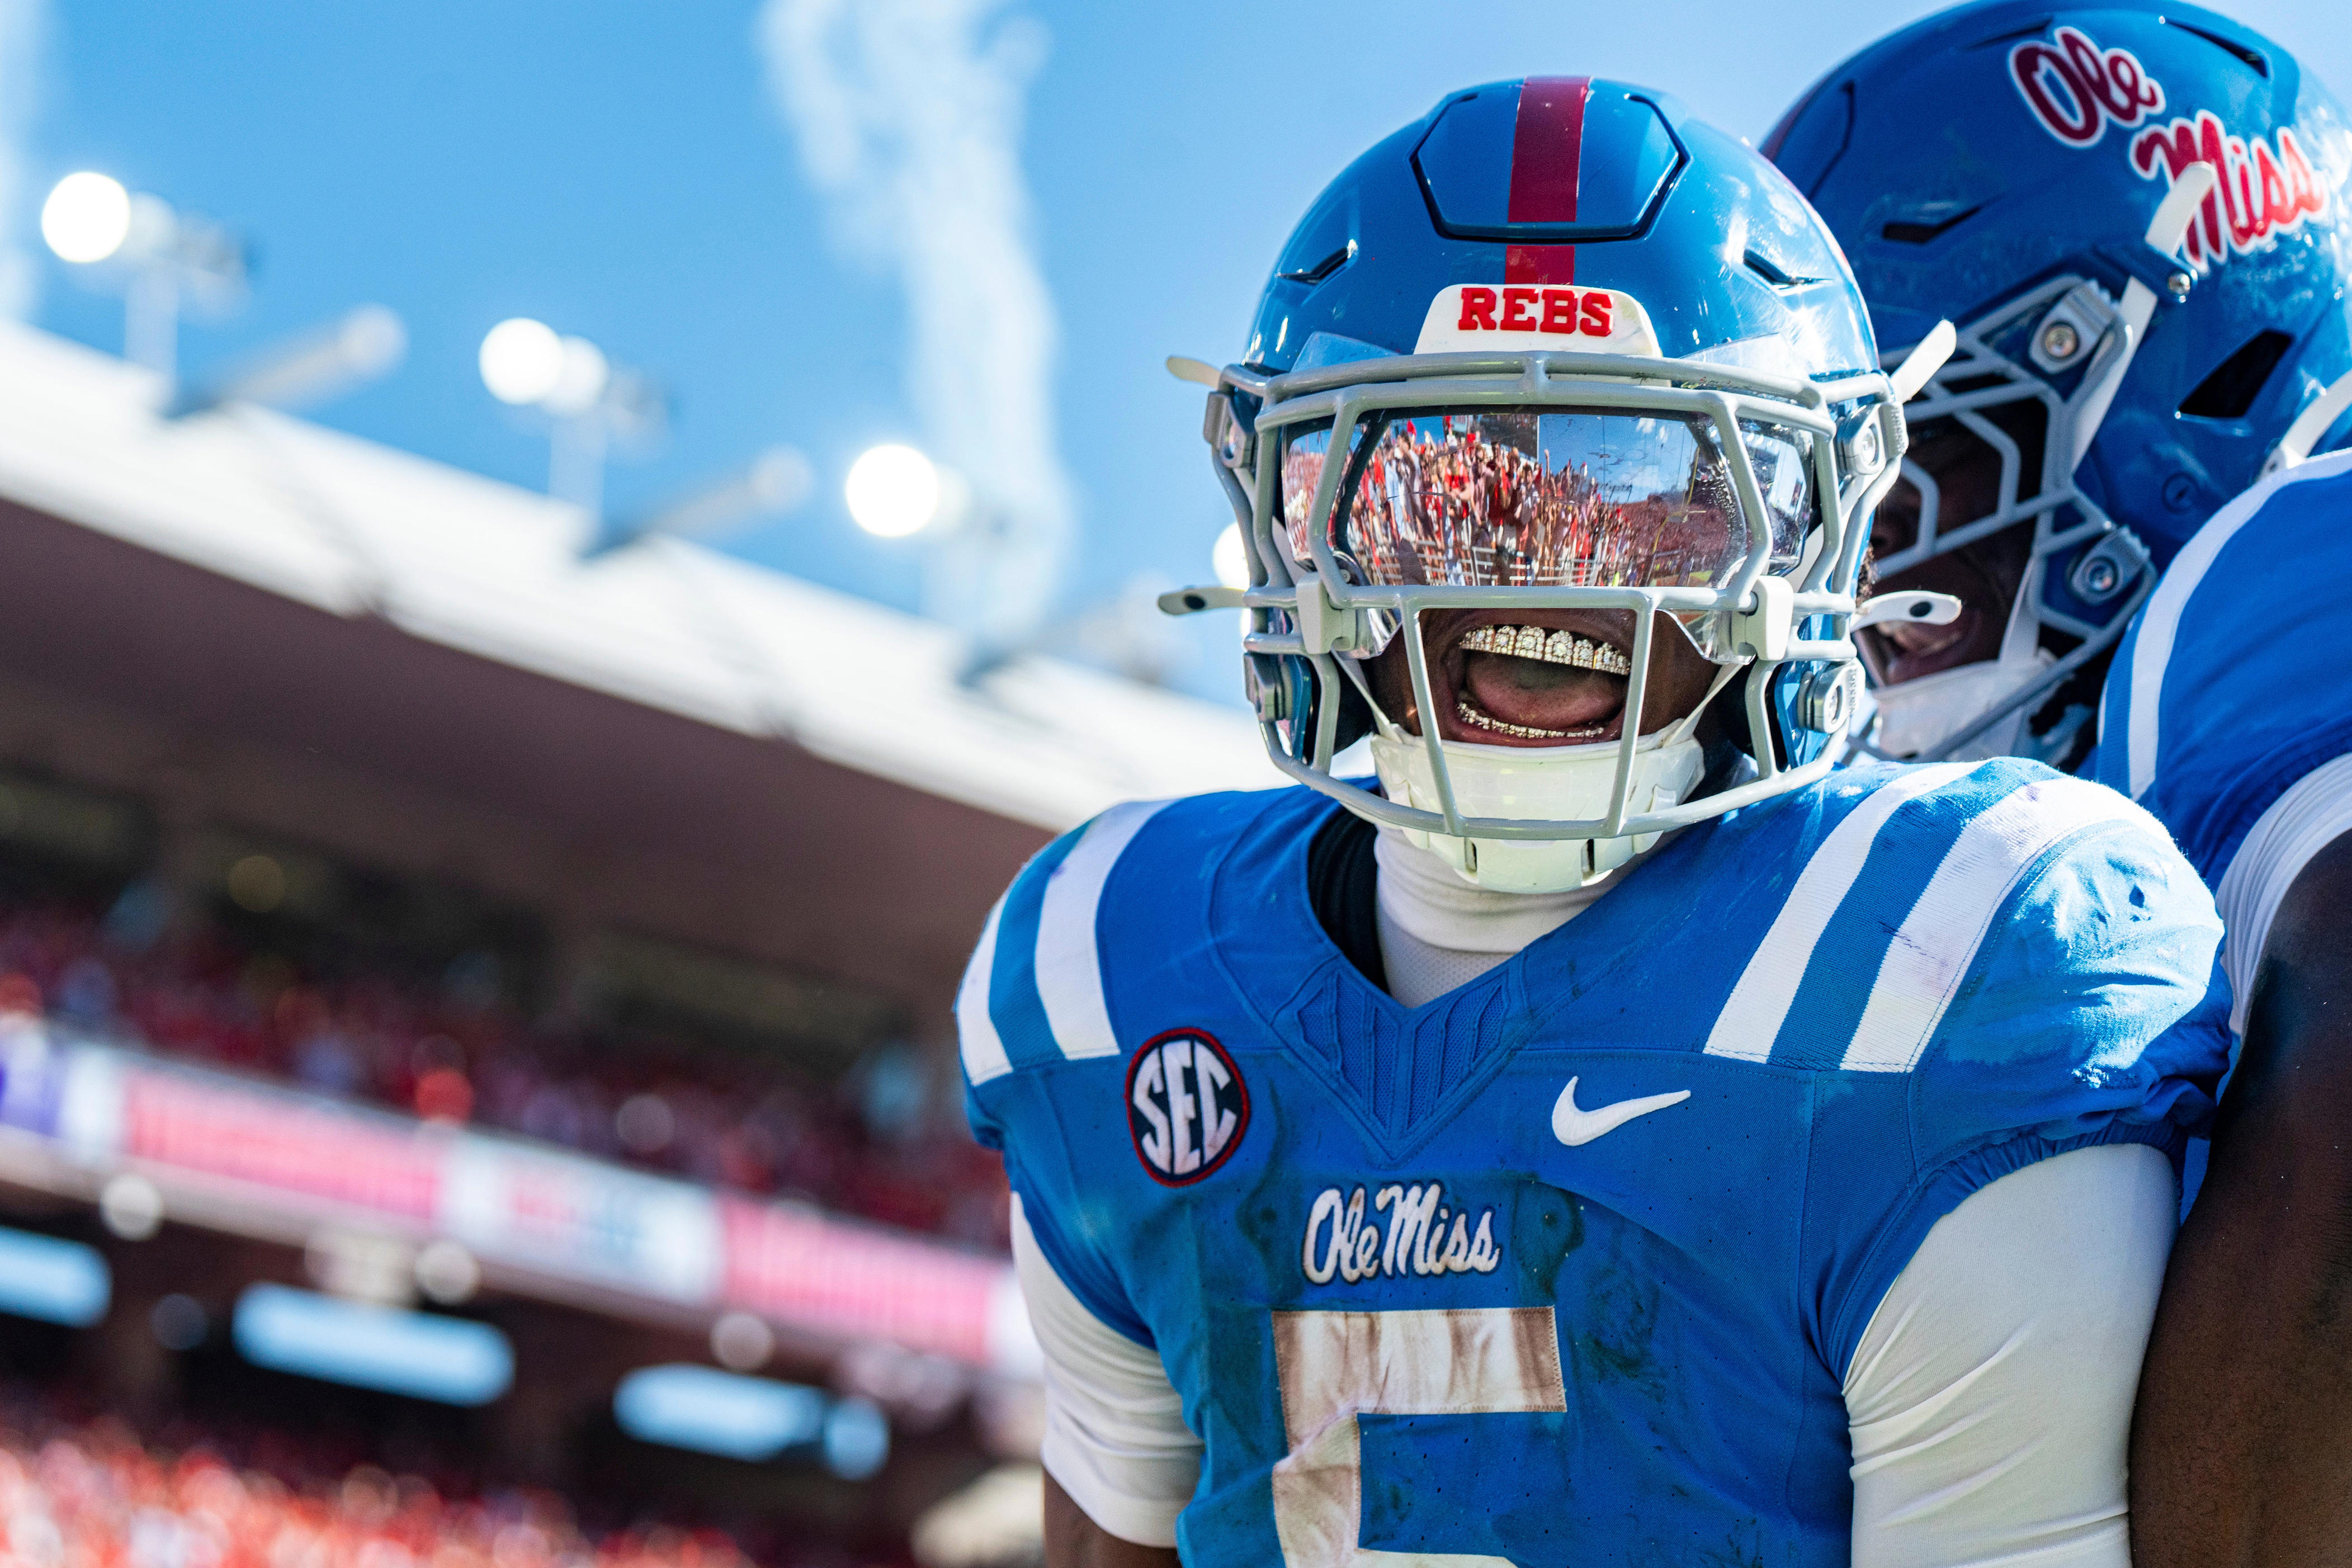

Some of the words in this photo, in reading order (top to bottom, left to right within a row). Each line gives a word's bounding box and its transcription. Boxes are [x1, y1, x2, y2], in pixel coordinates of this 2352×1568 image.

[2009, 26, 2166, 148] Ole
[2129, 110, 2328, 275] Miss
[1458, 287, 1614, 337] REBS
[1134, 1040, 1236, 1174] SEC
[1304, 1187, 1378, 1284] Ole
[1376, 1181, 1500, 1277] Miss
